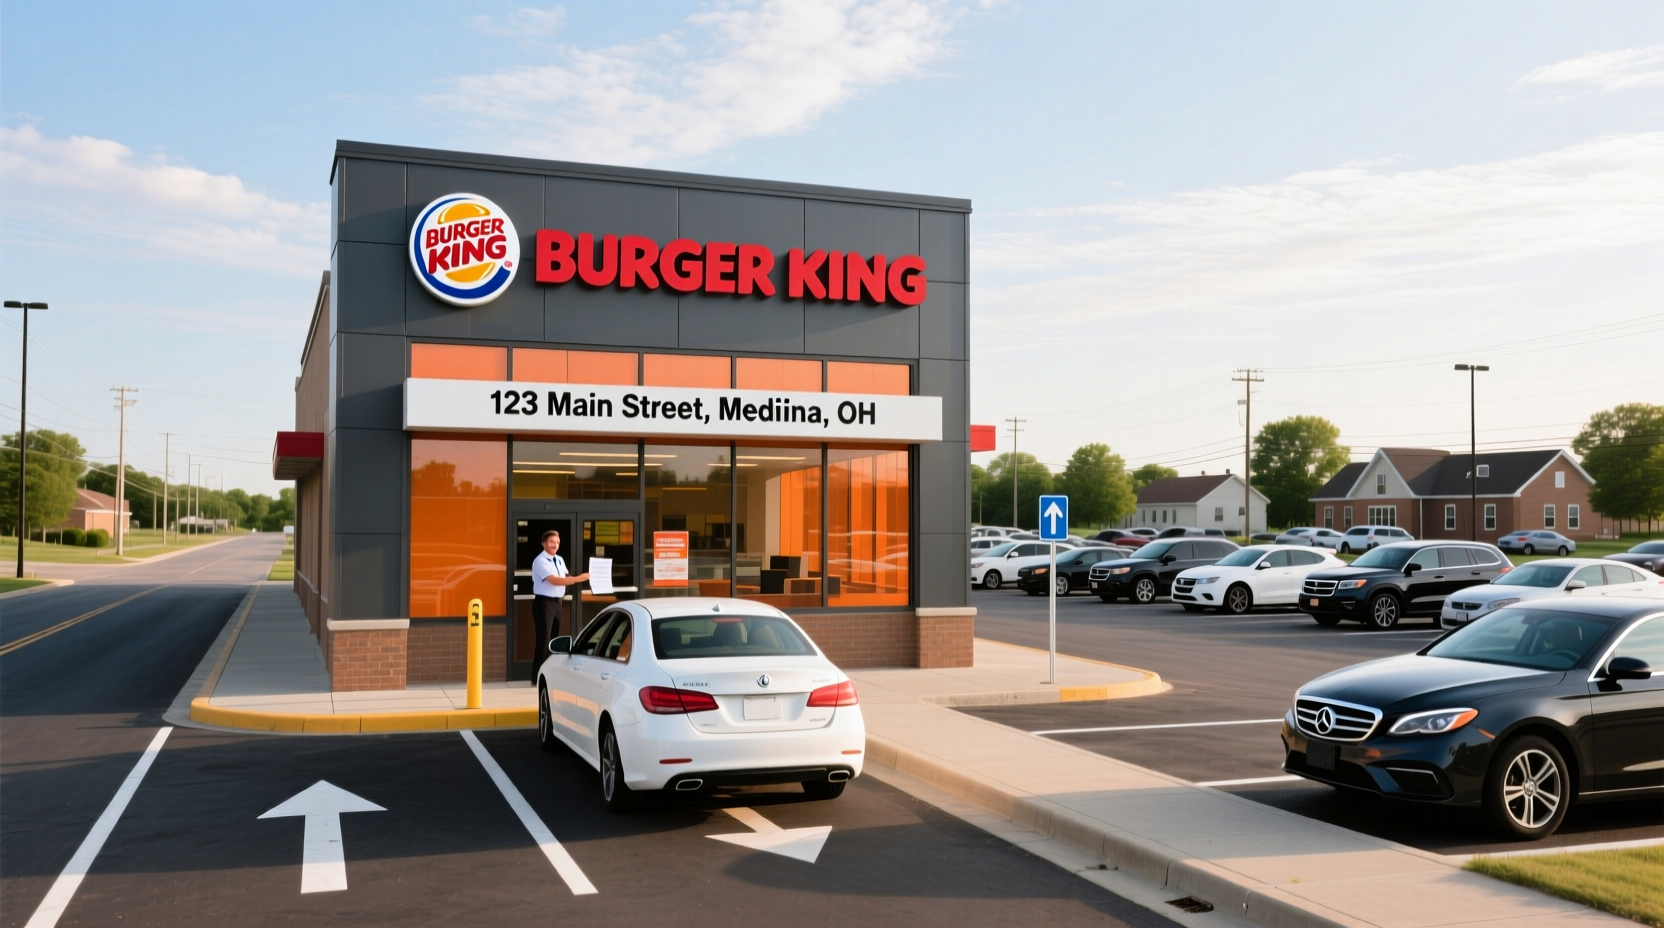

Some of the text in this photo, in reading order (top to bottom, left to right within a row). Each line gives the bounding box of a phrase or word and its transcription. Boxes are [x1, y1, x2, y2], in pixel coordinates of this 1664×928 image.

[426, 218, 504, 249] BURGER
[428, 235, 507, 275] KING
[535, 228, 928, 306] BURGER KING
[490, 390, 876, 429] 123 Main Street, Mediina, OH
